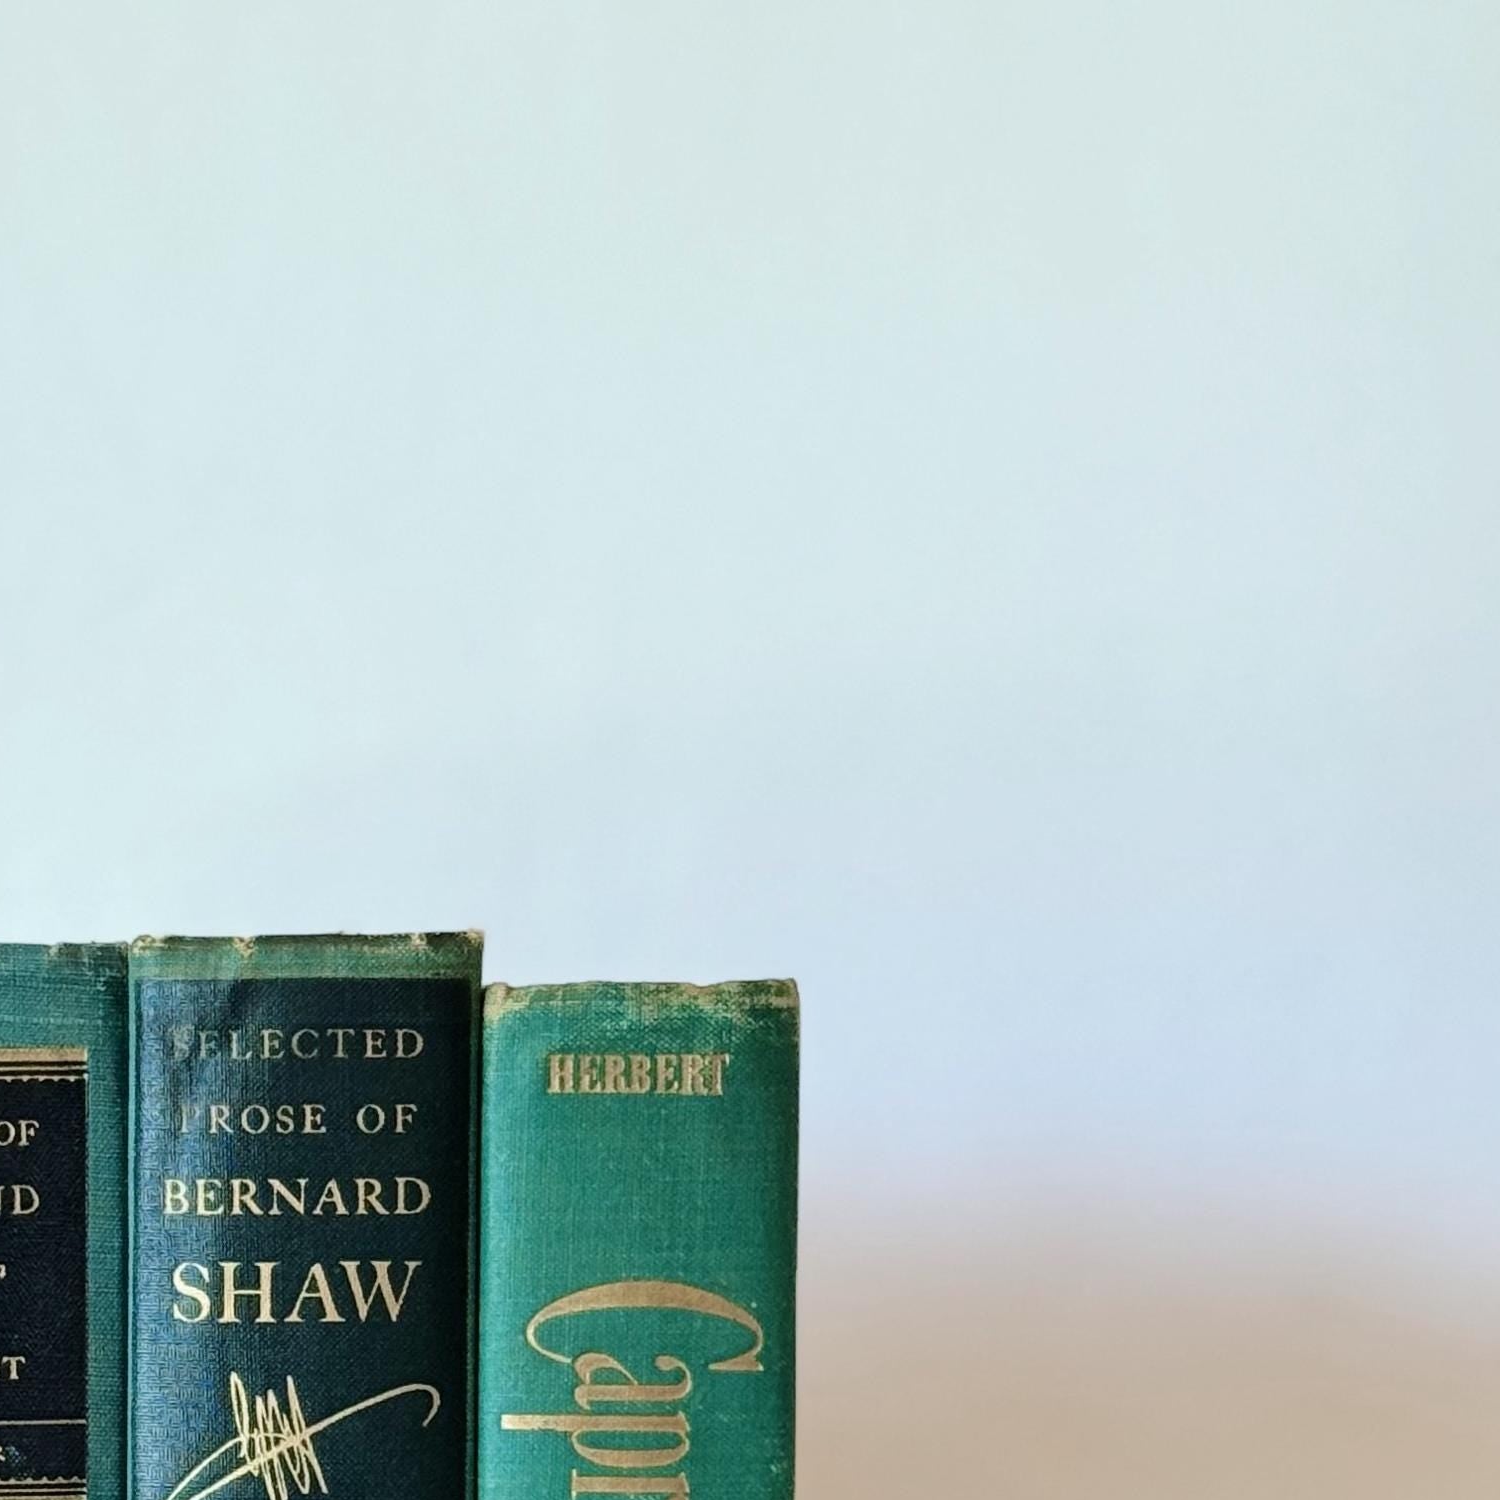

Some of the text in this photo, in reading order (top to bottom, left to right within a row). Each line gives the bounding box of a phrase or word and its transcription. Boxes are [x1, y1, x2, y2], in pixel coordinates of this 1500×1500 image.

[547, 1051, 731, 1096] HERBERT
[180, 1103, 418, 1135] PROSE OF
[164, 1177, 431, 1216] BERNARD
[172, 1260, 422, 1323] SHAW
